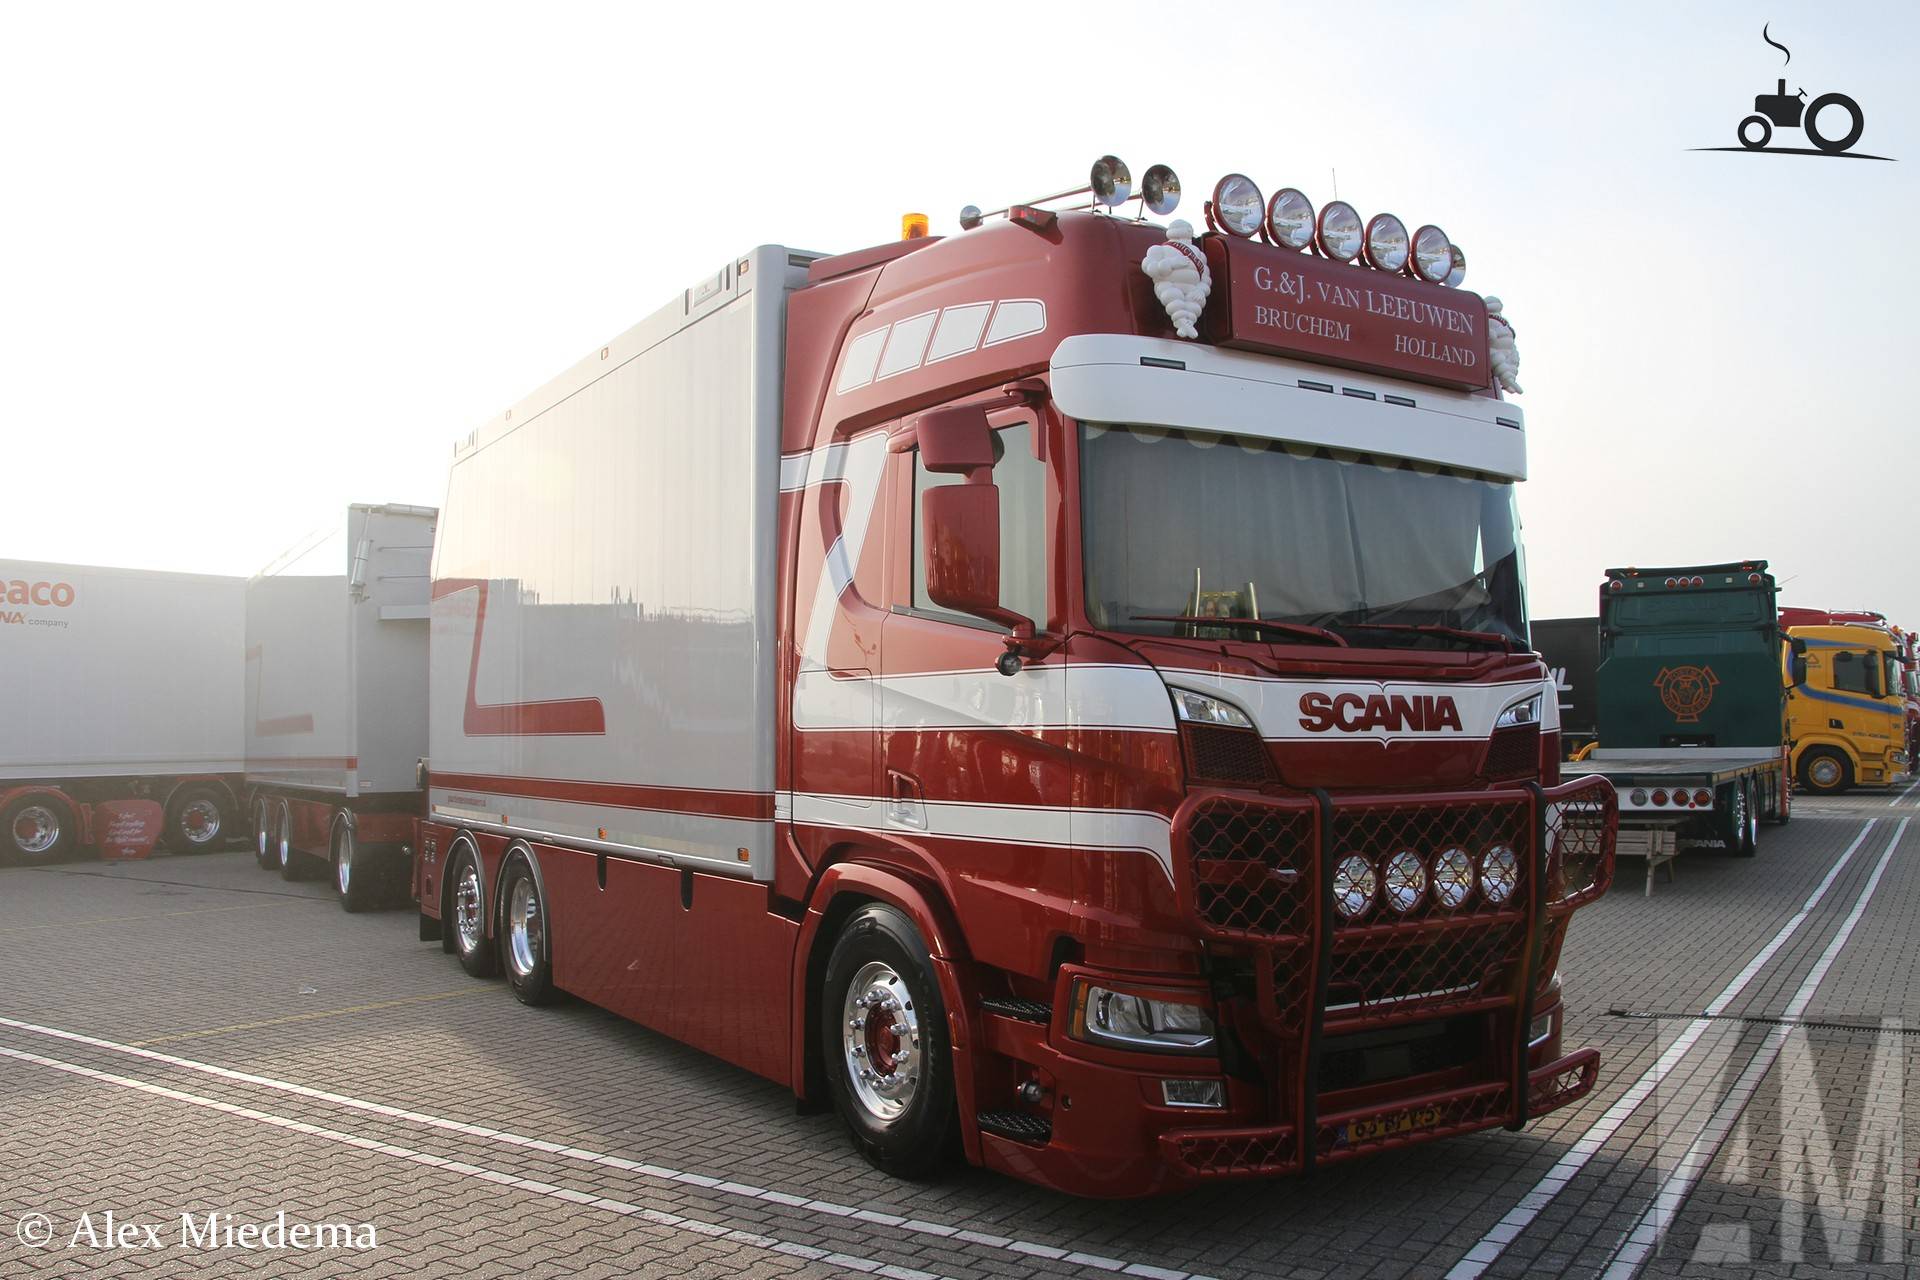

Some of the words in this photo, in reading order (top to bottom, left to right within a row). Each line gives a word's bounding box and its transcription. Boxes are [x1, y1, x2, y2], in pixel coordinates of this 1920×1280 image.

[1255, 305, 1351, 341] BRUCHEM
[1394, 334, 1476, 367] HOLLAND
[1316, 281, 1360, 310] VAN
[1365, 289, 1474, 336] LEEUWEN
[1298, 691, 1463, 733] SCANIA
